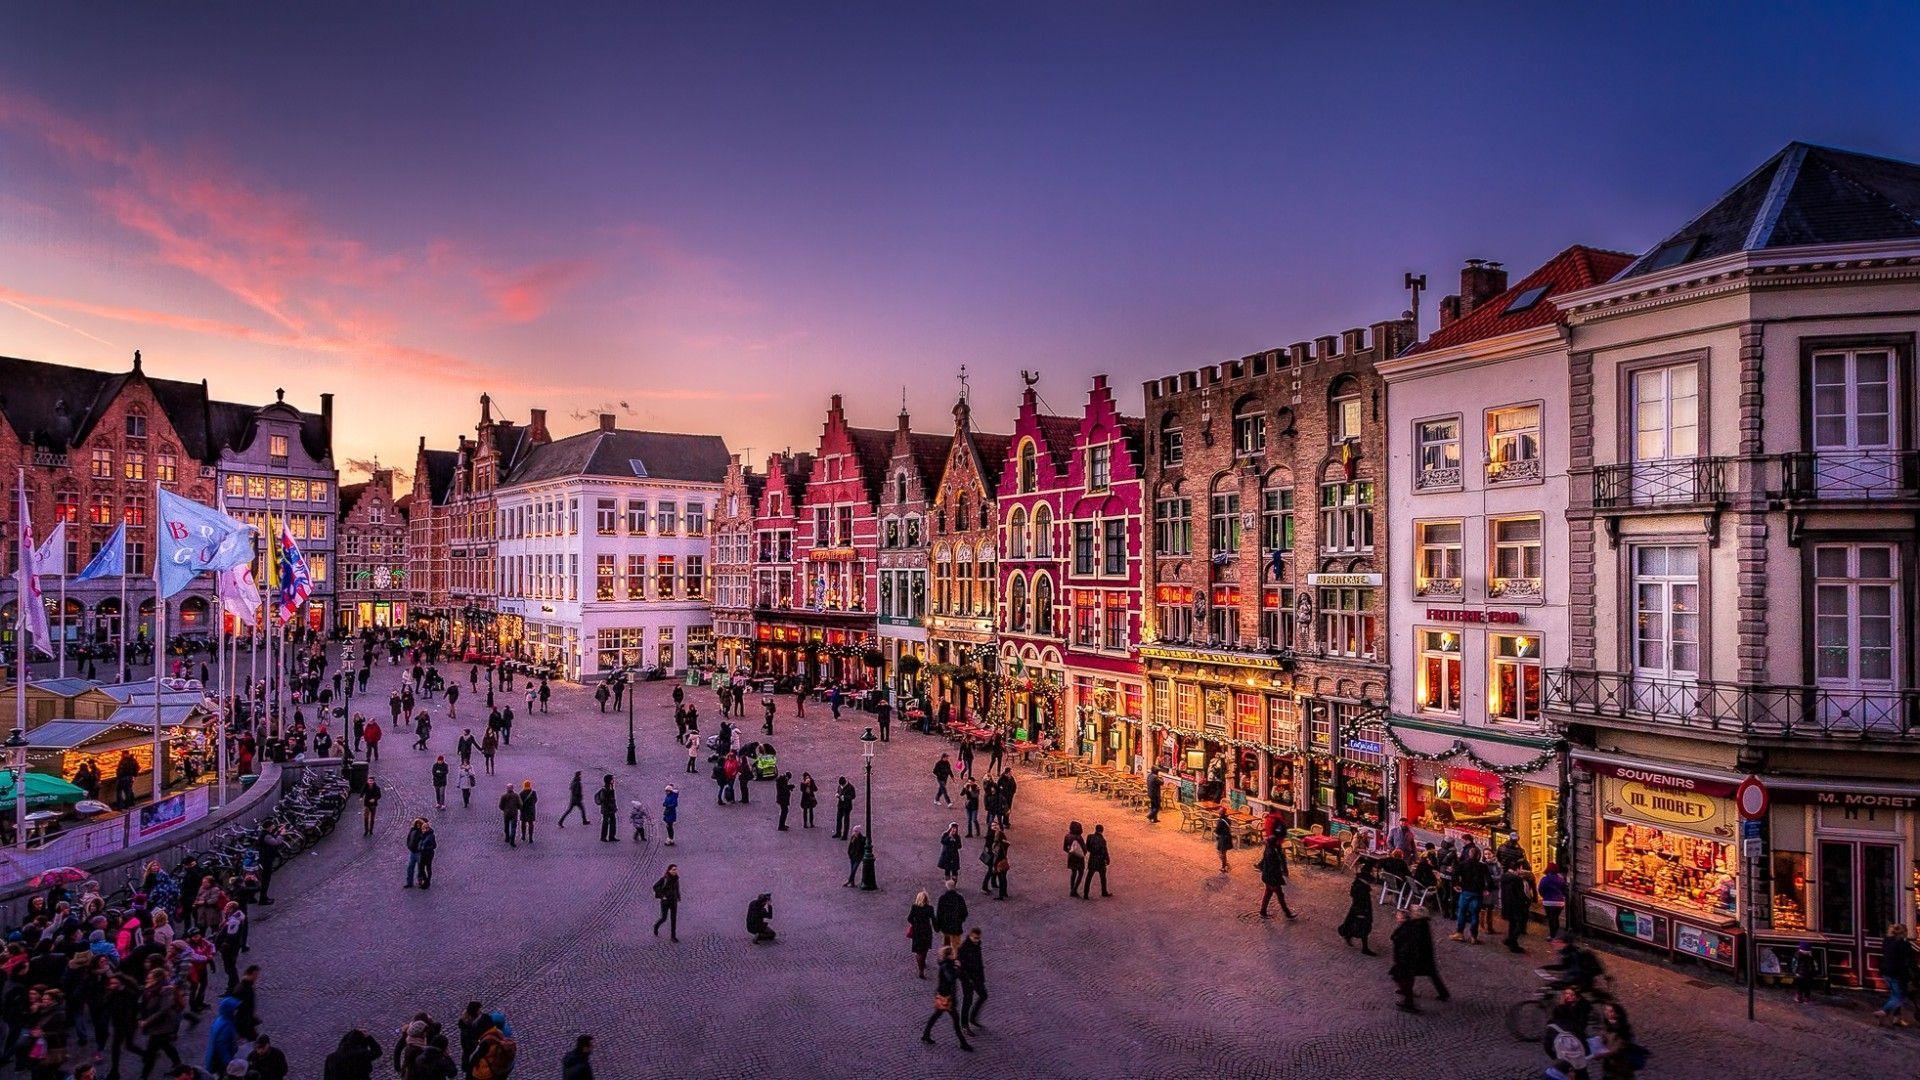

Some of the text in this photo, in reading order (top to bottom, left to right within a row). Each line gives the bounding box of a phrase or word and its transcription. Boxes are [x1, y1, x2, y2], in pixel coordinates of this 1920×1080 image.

[1427, 609, 1484, 622] FRITERIE
[1617, 768, 1695, 789] SOUVENIRS
[1451, 781, 1485, 796] FRITERIE
[1467, 794, 1485, 805] 1900
[1652, 795, 1706, 818] MORET
[1819, 793, 1916, 807] M. MORET
